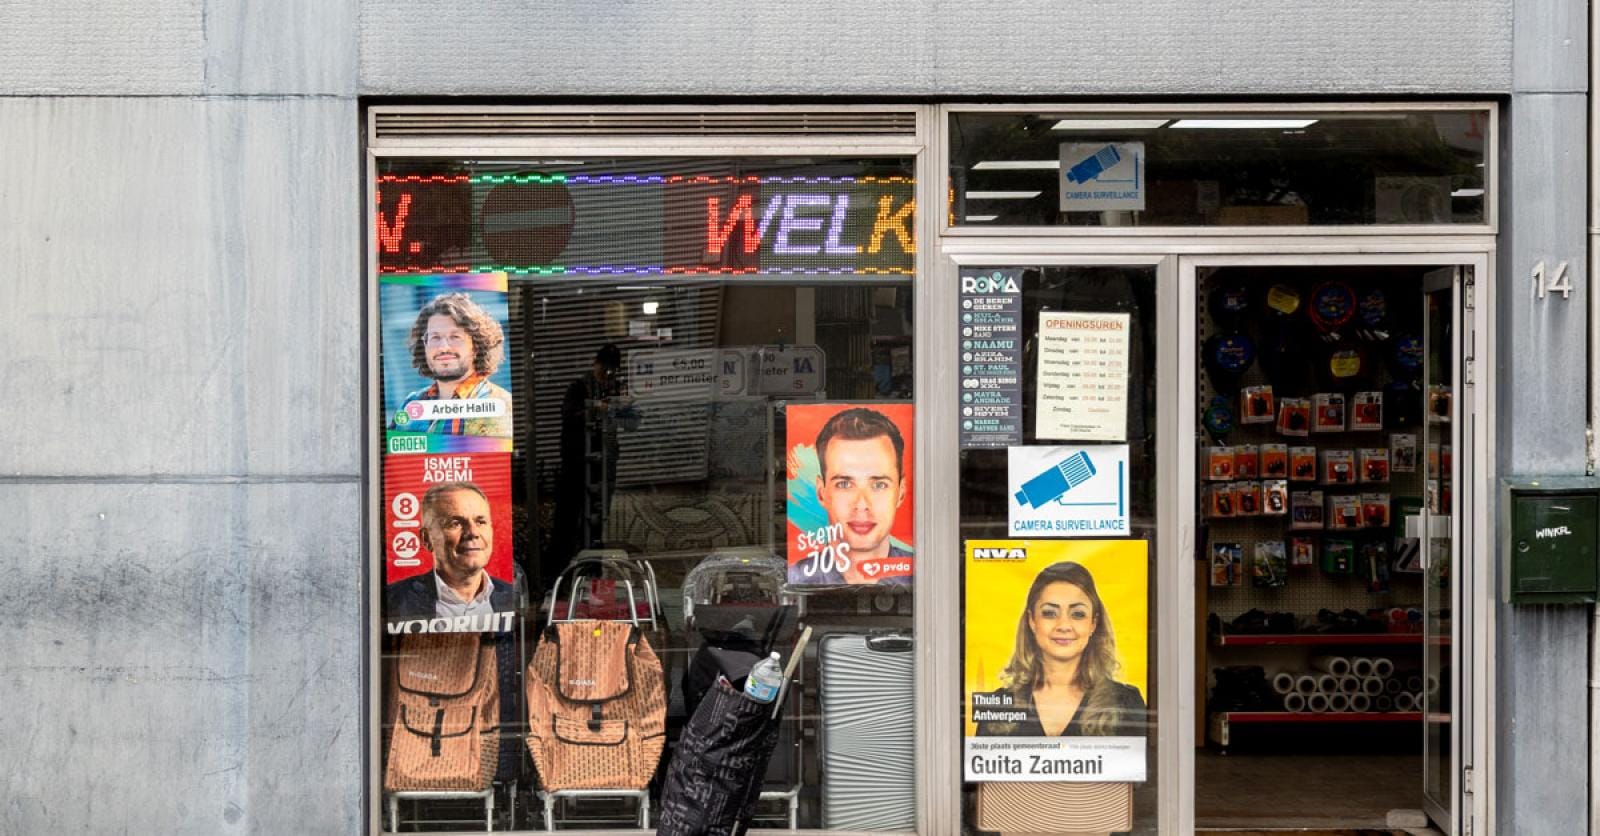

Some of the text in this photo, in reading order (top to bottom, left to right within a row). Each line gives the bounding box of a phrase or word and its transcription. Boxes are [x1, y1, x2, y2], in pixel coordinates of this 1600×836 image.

[1065, 191, 1139, 199] CAMERA SURVEILLANCE
[962, 273, 1021, 293] ROMA
[1531, 261, 1573, 300] 14
[1046, 319, 1123, 330] OPENINGSUREN
[974, 341, 1013, 349] NAAMU
[432, 402, 495, 414] Arbër Halili
[391, 436, 426, 452] GROEN
[424, 457, 472, 469] ISMET
[423, 469, 473, 482] ADEMI
[399, 497, 413, 515] 8
[1014, 519, 1125, 531] CAMERA SURVEILLANCE
[797, 522, 844, 551] stem
[1535, 525, 1572, 540] WINKEL
[395, 537, 418, 552] 24
[883, 562, 910, 573] pvda
[387, 611, 515, 635] VOORUIT
[974, 694, 1012, 705] Thuis in
[973, 710, 1026, 723] Antwerpen
[990, 742, 1011, 751] plaats
[1013, 742, 1060, 751] gemeenteraad
[971, 755, 1103, 775] Guita Zamani
